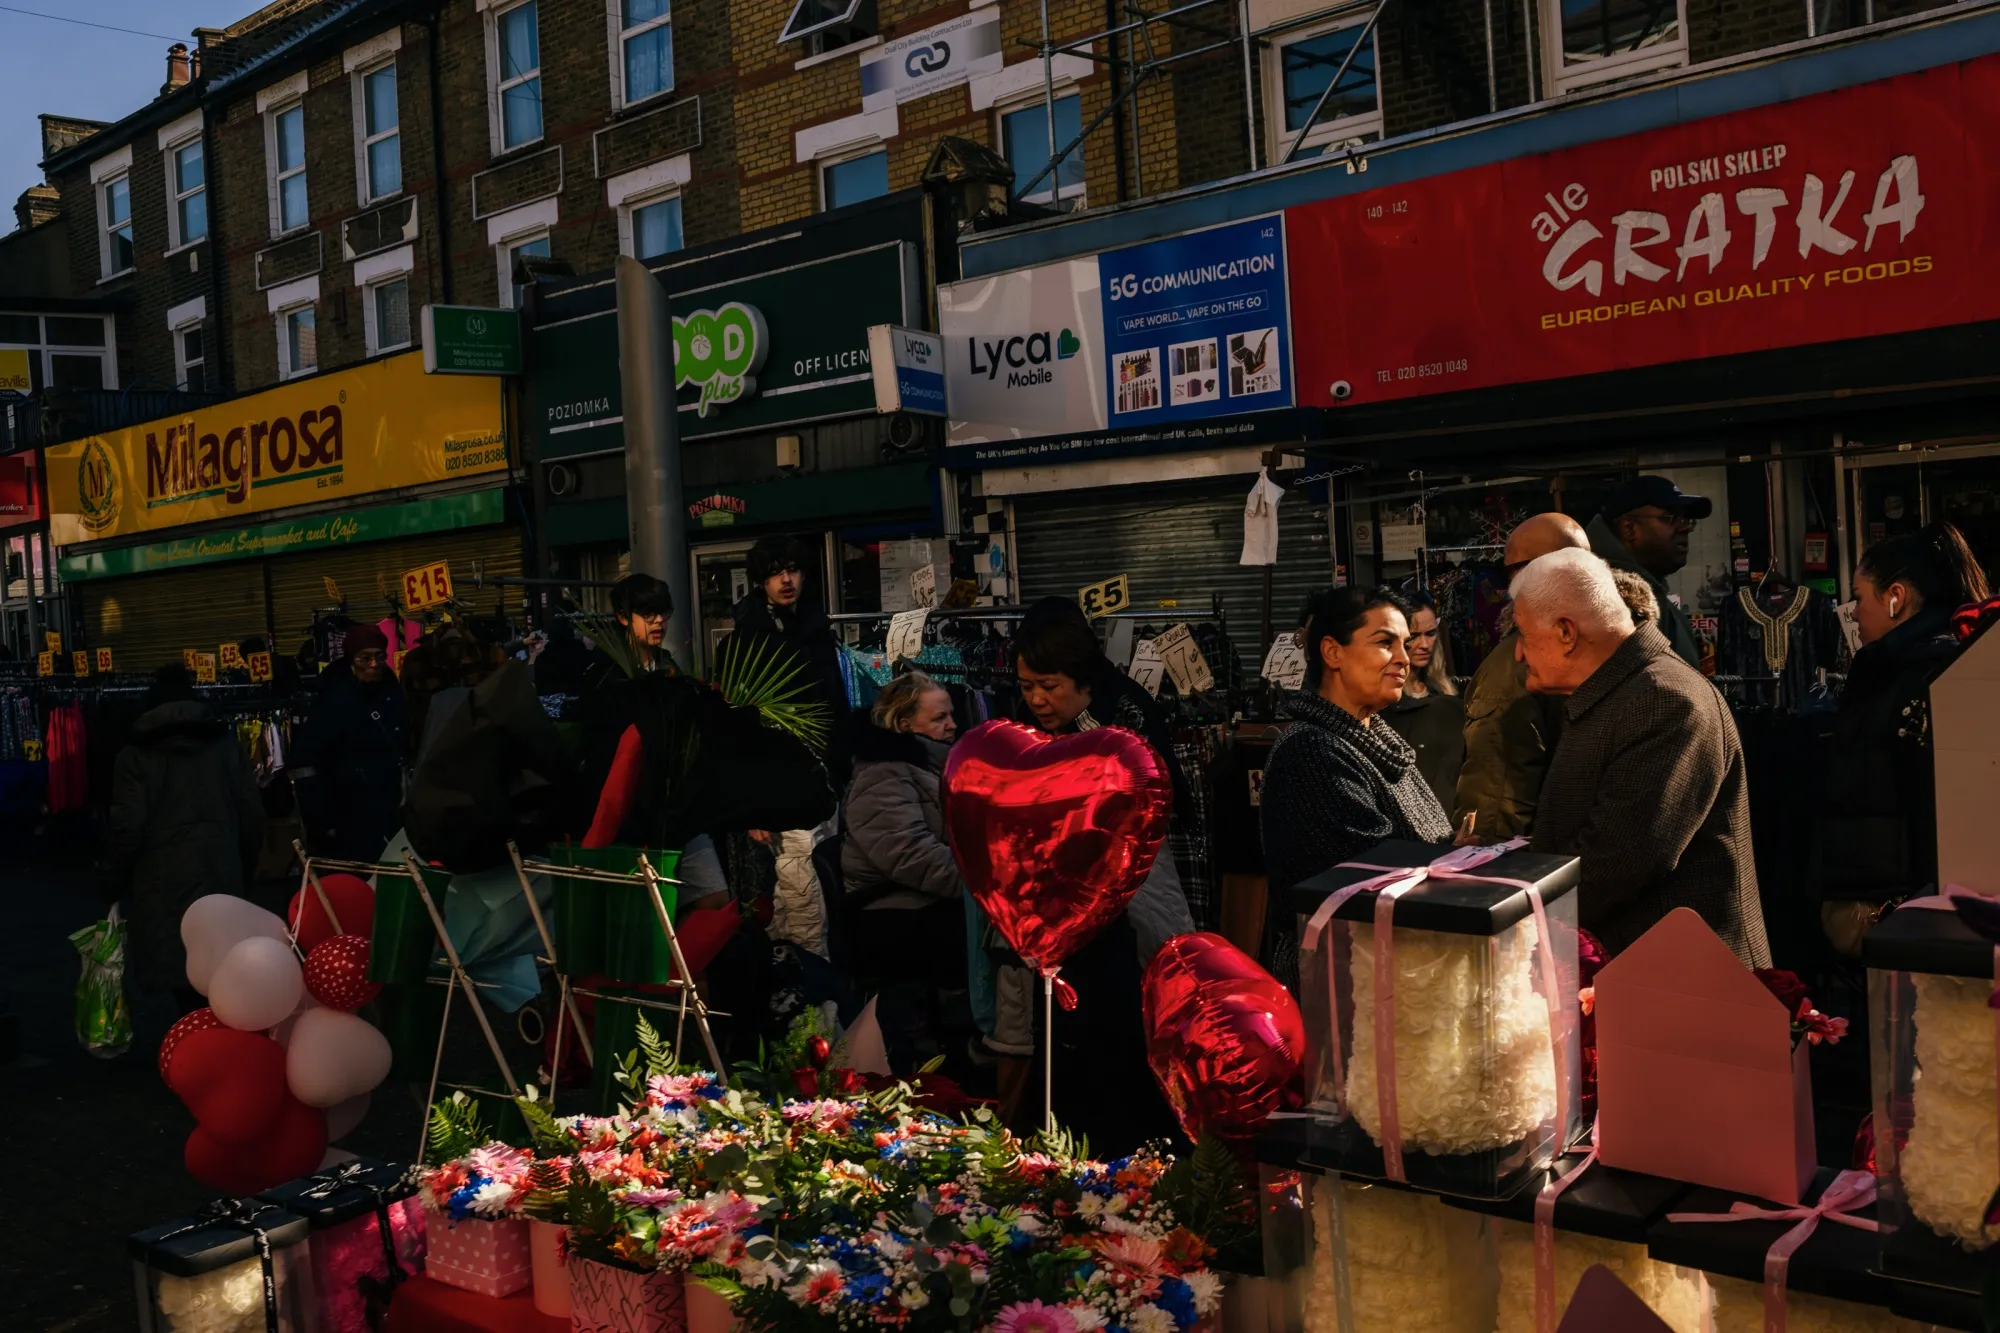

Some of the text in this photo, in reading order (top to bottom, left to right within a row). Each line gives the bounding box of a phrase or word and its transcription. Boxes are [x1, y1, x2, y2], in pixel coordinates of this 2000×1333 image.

[884, 18, 972, 54] Dual City Building Contractors Ltd
[1650, 144, 1787, 192] POLSKI SKLEP
[1366, 205, 1382, 220] 140
[1392, 200, 1408, 214] 142
[1531, 181, 1589, 242] ale
[1542, 154, 1926, 297] GRATKA
[1261, 227, 1274, 239] 142
[1109, 253, 1275, 301] 5G COMMUNICATION
[1541, 255, 1933, 330] EUROPEAN QUALITY FOODS
[1123, 316, 1145, 331] VAPE
[1186, 305, 1209, 320] VAPE
[1211, 303, 1226, 315] ON
[1227, 299, 1245, 312] THE
[1246, 296, 1262, 308] GO
[904, 334, 926, 356] Lyca
[969, 331, 1051, 380] Lyca
[794, 357, 821, 377] OFF
[1007, 367, 1052, 388] Mobile
[1397, 366, 1415, 380] 020
[1418, 362, 1442, 377] 8520
[1445, 358, 1468, 373] 1048
[548, 397, 610, 421] POZIOMKA
[701, 376, 741, 415] plus
[146, 405, 343, 504] Milagrosa
[975, 451, 987, 459] The
[1028, 446, 1040, 455] Pay
[1040, 444, 1049, 452] As
[1049, 442, 1060, 451] You
[1061, 441, 1070, 450] Go
[1070, 440, 1082, 448] SIM
[1083, 439, 1092, 447] for
[1094, 437, 1104, 446] low
[1162, 430, 1174, 440] and
[1175, 429, 1186, 438] UK
[1206, 427, 1223, 436] texts
[1225, 424, 1237, 433] and
[1239, 423, 1255, 432] data
[87, 459, 104, 499] M
[445, 456, 460, 470] 020
[197, 537, 235, 557] Oriental
[237, 526, 303, 552] Supermarket
[306, 521, 328, 541] and
[330, 516, 358, 542] Cafe
[406, 567, 447, 605] £15
[1084, 580, 1122, 614] £5
[222, 647, 236, 664] £5
[251, 656, 269, 677] £5
